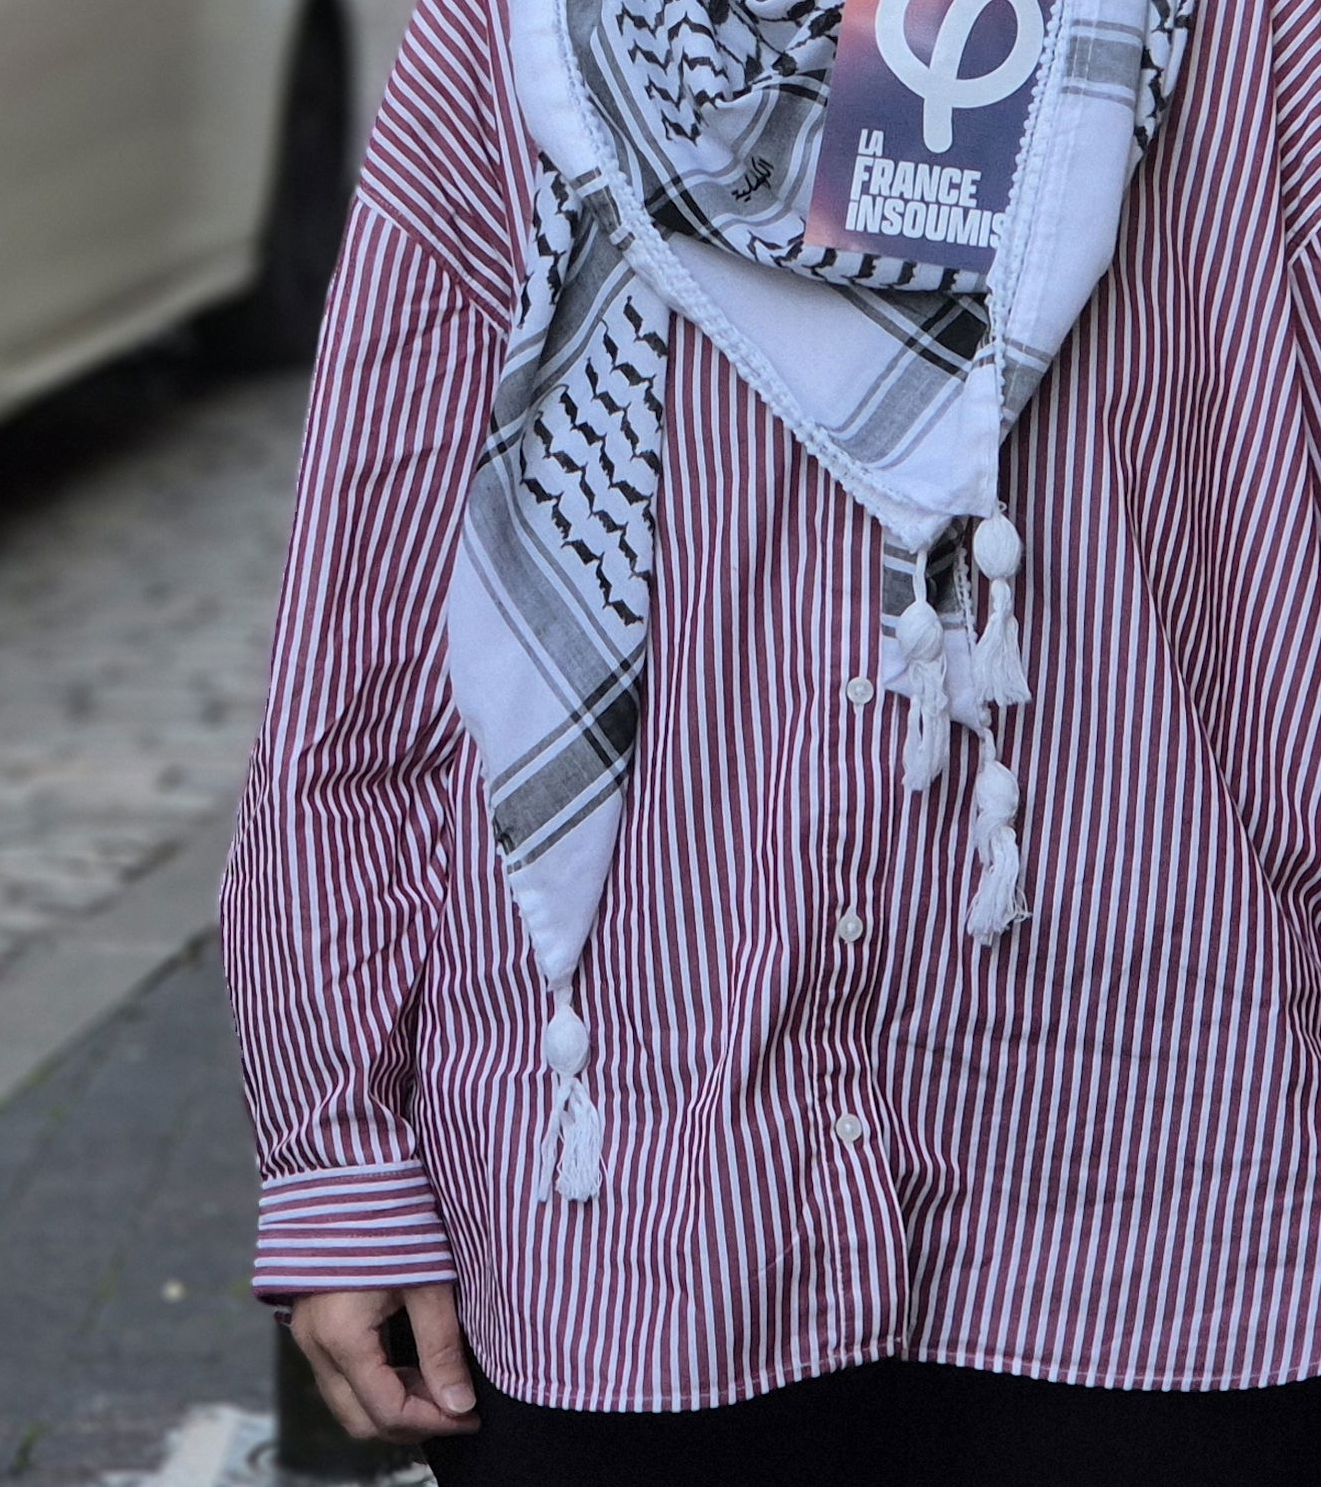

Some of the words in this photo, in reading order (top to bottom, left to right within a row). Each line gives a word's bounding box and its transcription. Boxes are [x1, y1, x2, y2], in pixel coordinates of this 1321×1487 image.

[857, 128, 885, 157] LA
[850, 155, 982, 208] FRANCE
[845, 194, 1006, 250] INSOUMIS
